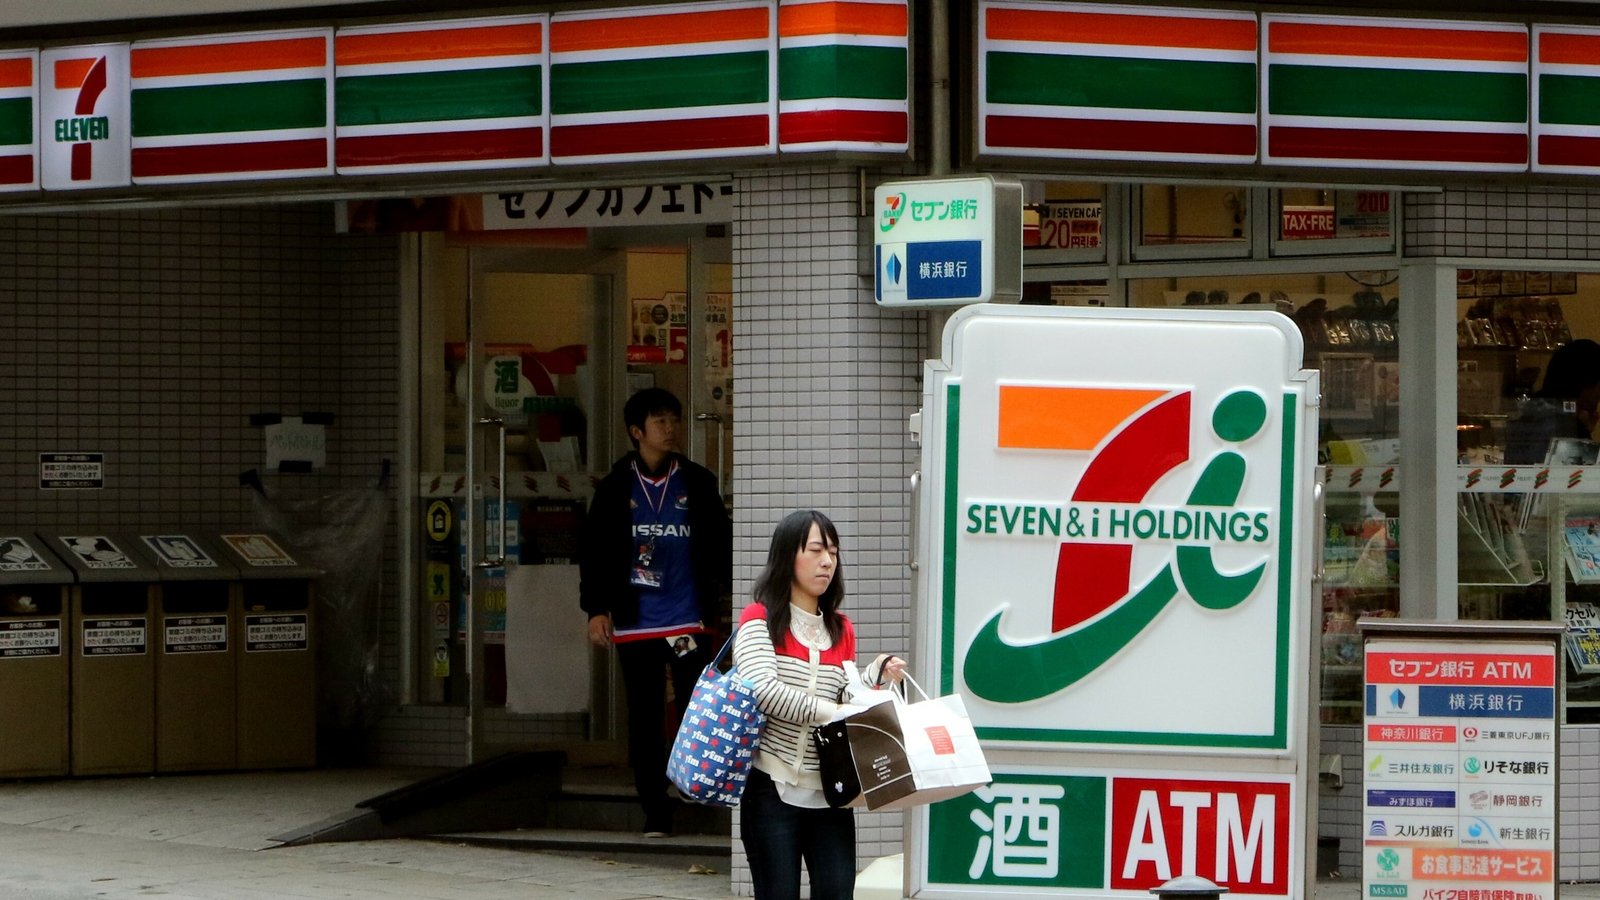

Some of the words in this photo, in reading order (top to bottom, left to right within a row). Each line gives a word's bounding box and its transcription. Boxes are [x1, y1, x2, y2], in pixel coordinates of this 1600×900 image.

[911, 200, 977, 221] セブン銀行
[1057, 208, 1084, 218] SEVEN
[1044, 220, 1070, 248] 20
[919, 261, 967, 279] 横浜銀行
[494, 360, 518, 393] 酒
[632, 524, 691, 537] ISSAN
[1109, 508, 1269, 542] HOLDINGS
[1566, 608, 1596, 620] クセル
[1389, 659, 1474, 678] セブン銀行
[1483, 662, 1532, 679] ATM
[1449, 694, 1523, 712] 横浜銀行
[1381, 727, 1444, 741] 神奈川銀行
[1482, 730, 1550, 740] 三菱東京UFJ銀行
[1388, 764, 1454, 774] 三井住友銀行
[1484, 760, 1549, 775] りそな銀行
[1389, 797, 1434, 806] みずほ銀行
[969, 782, 1065, 880] 酒
[1122, 789, 1276, 884] ATM
[1394, 825, 1454, 837] スルガ銀行
[1500, 828, 1550, 840] 新生銀行
[1422, 855, 1543, 876] お食事配達サービス
[1372, 887, 1406, 895] MS&AD
